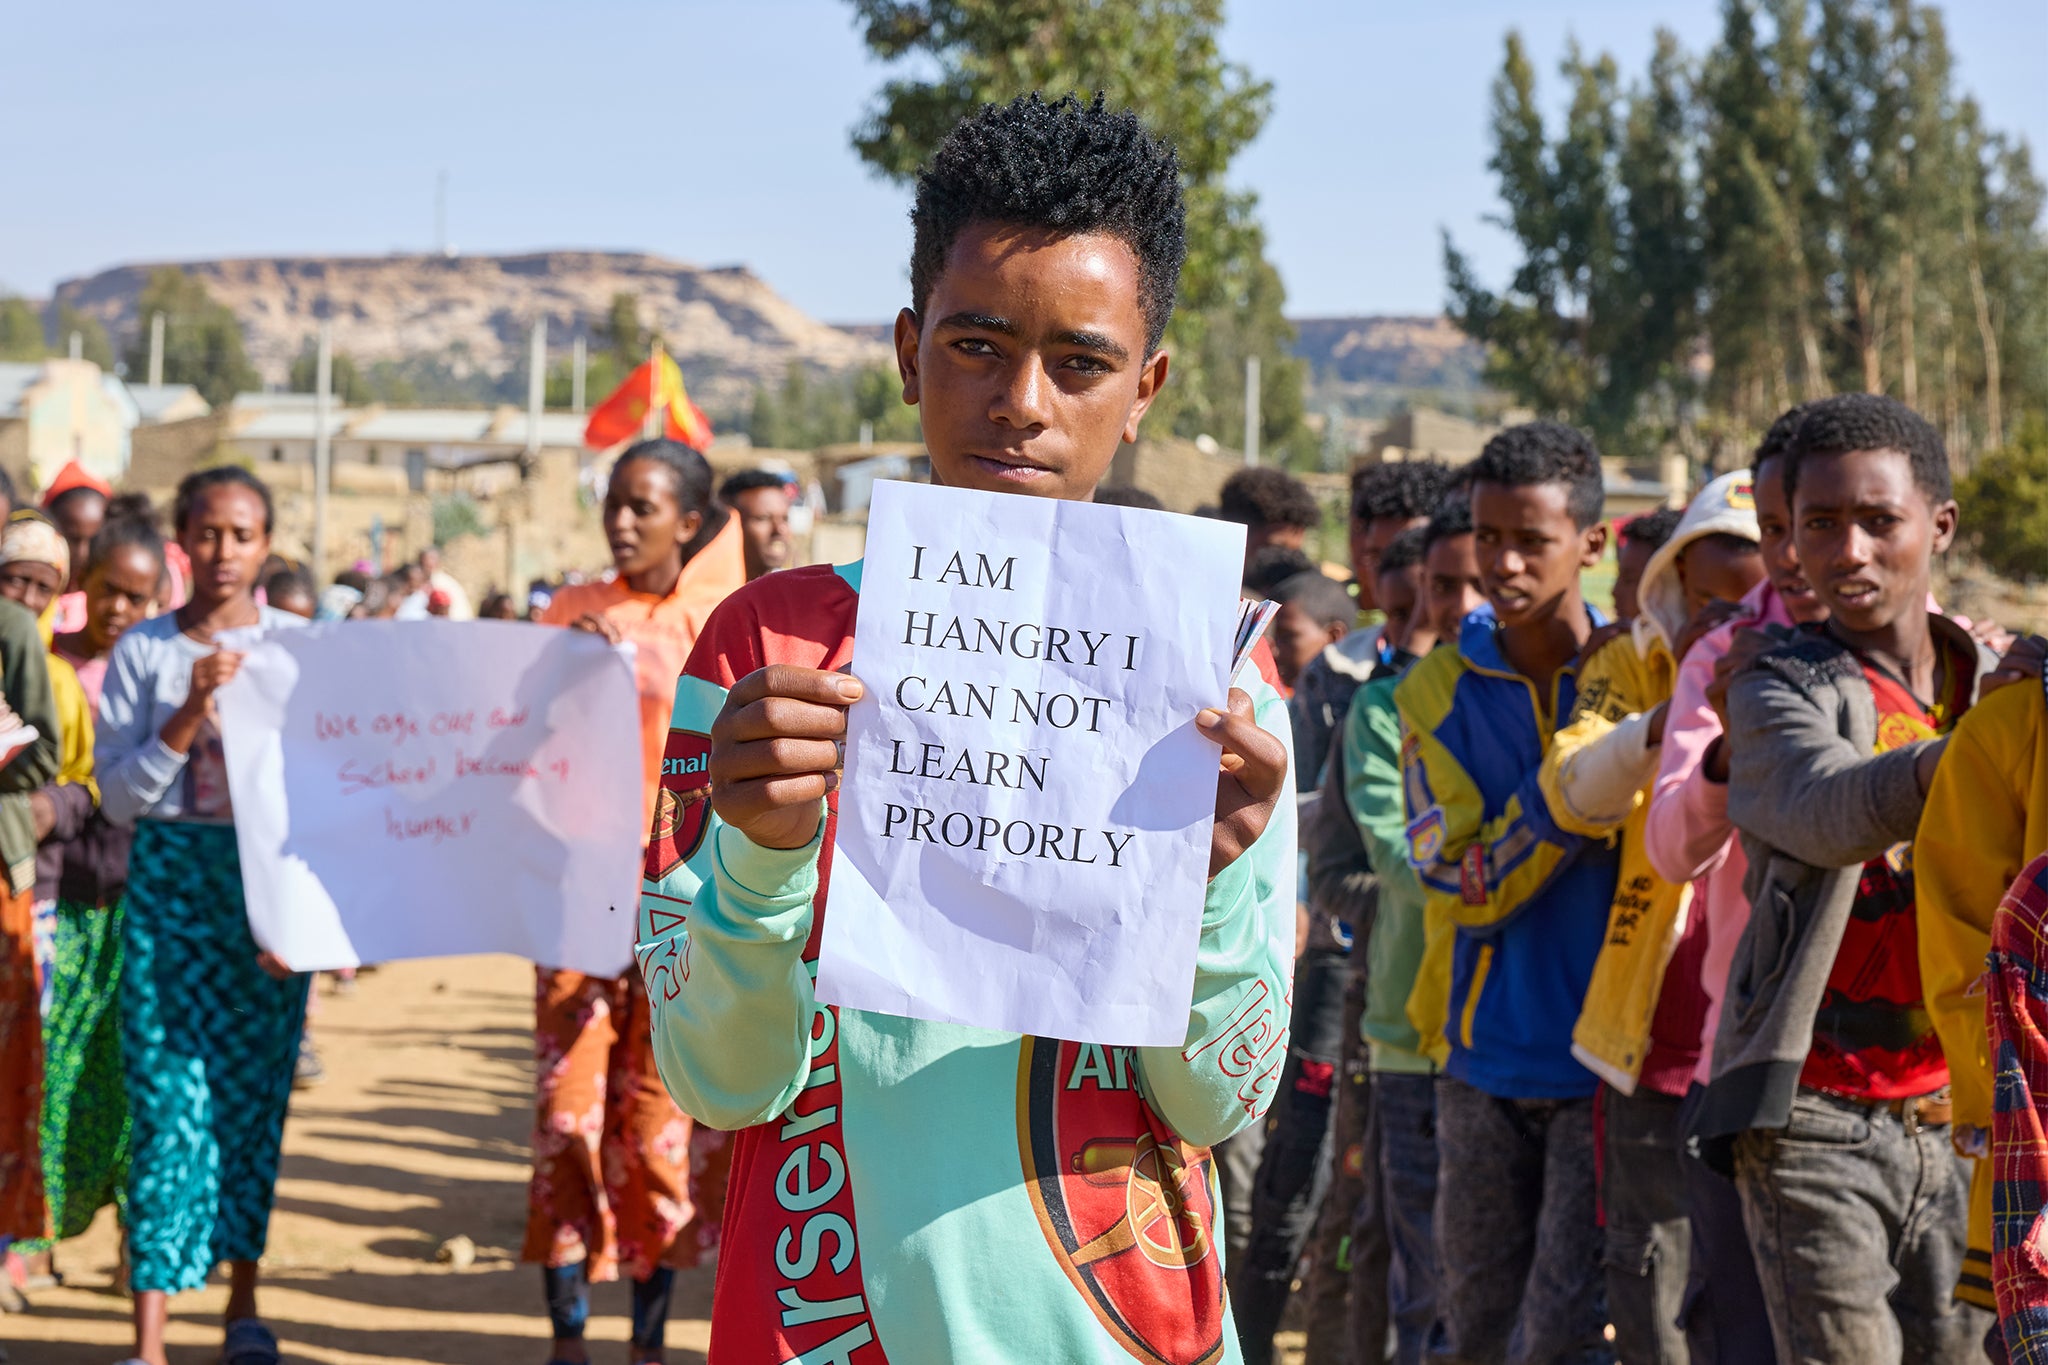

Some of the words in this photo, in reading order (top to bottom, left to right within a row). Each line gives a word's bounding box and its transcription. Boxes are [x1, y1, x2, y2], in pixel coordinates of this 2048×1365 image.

[909, 545, 926, 580] I
[936, 550, 1017, 591] AM
[901, 610, 1112, 667] HANGRY
[1122, 635, 1139, 671] I
[895, 676, 998, 720] CAN
[1009, 688, 1111, 733] NOT
[888, 738, 1051, 792] LEARN
[880, 802, 1136, 868] PROPORLY
